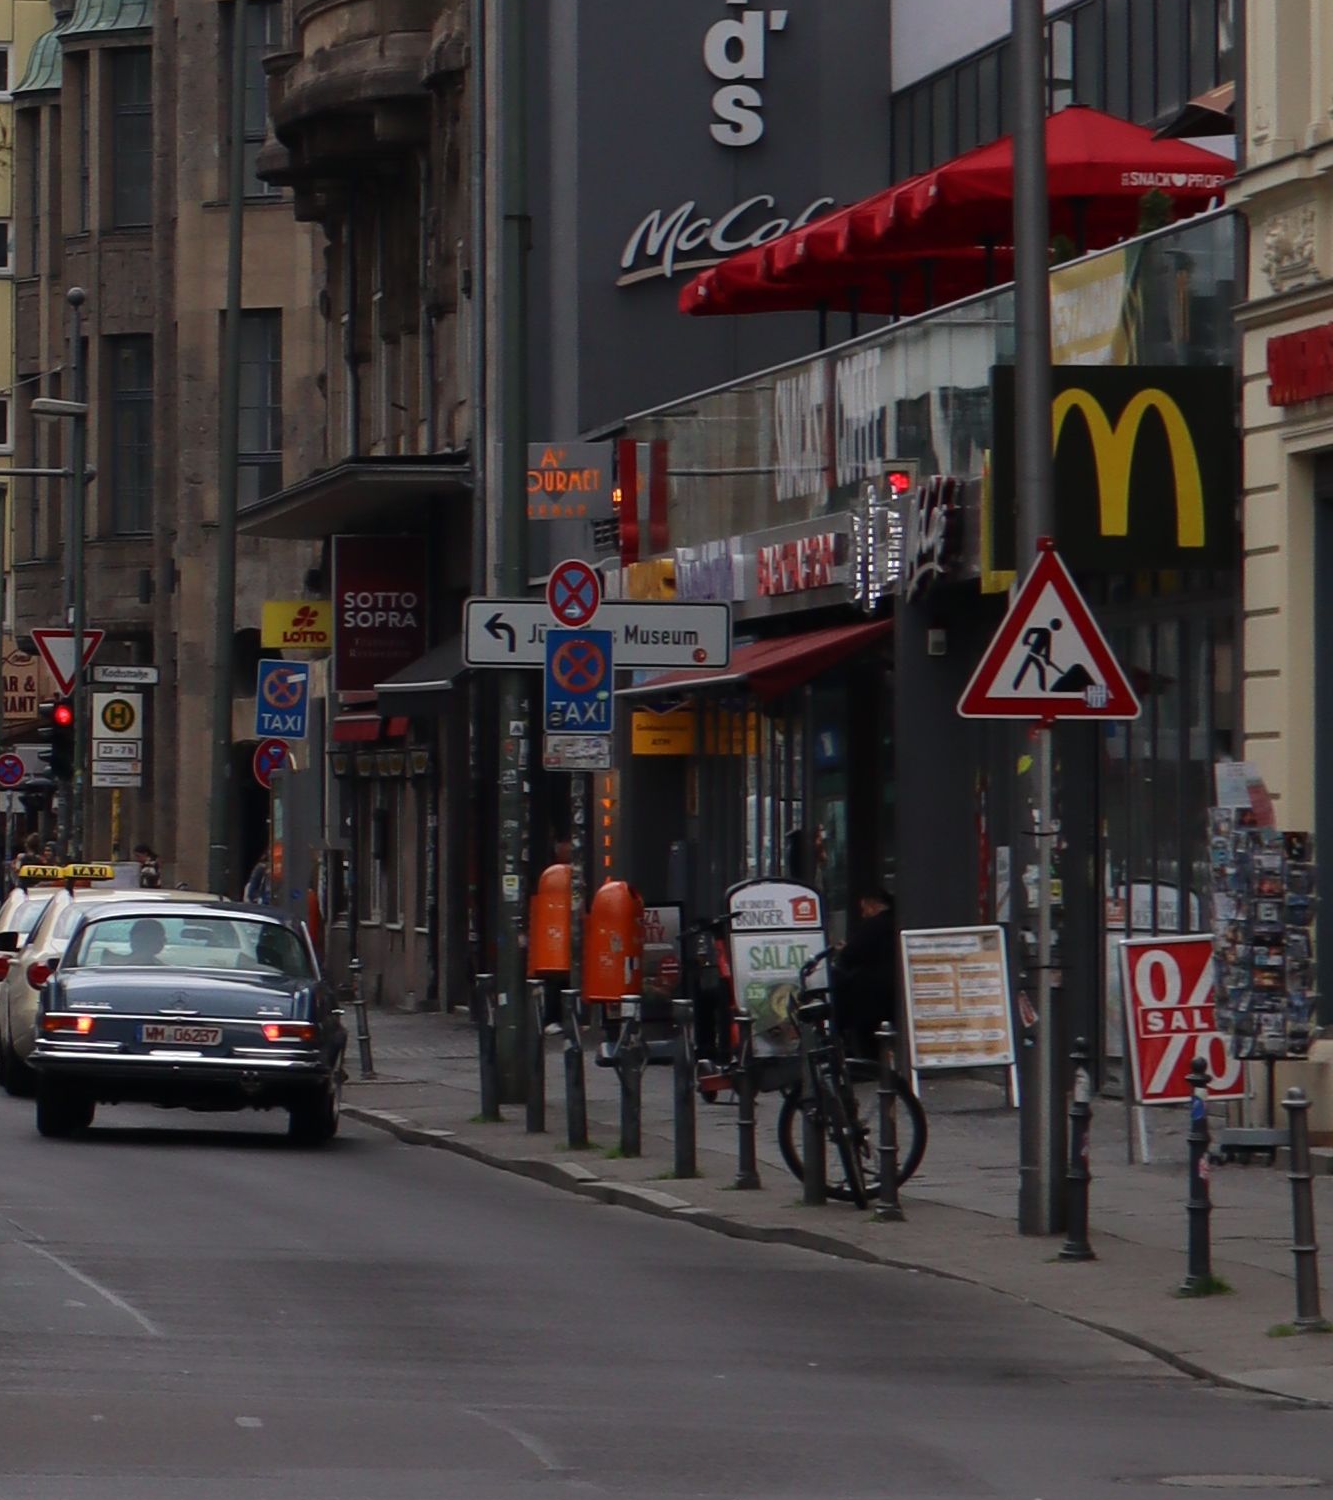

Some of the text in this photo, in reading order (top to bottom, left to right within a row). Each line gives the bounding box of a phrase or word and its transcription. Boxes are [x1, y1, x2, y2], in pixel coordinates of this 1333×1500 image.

[343, 592, 417, 608] SOTTO
[343, 611, 417, 627] SOPRA
[283, 631, 327, 642] LOTTO
[624, 624, 699, 645] Museum
[551, 701, 606, 723] TAXI
[261, 713, 302, 731] TAXI
[27, 867, 59, 877] TAXI
[73, 866, 108, 877] TAXI
[749, 945, 809, 971] SALAT
[1146, 1011, 1210, 1032] SAL
[145, 1026, 166, 1041] WM
